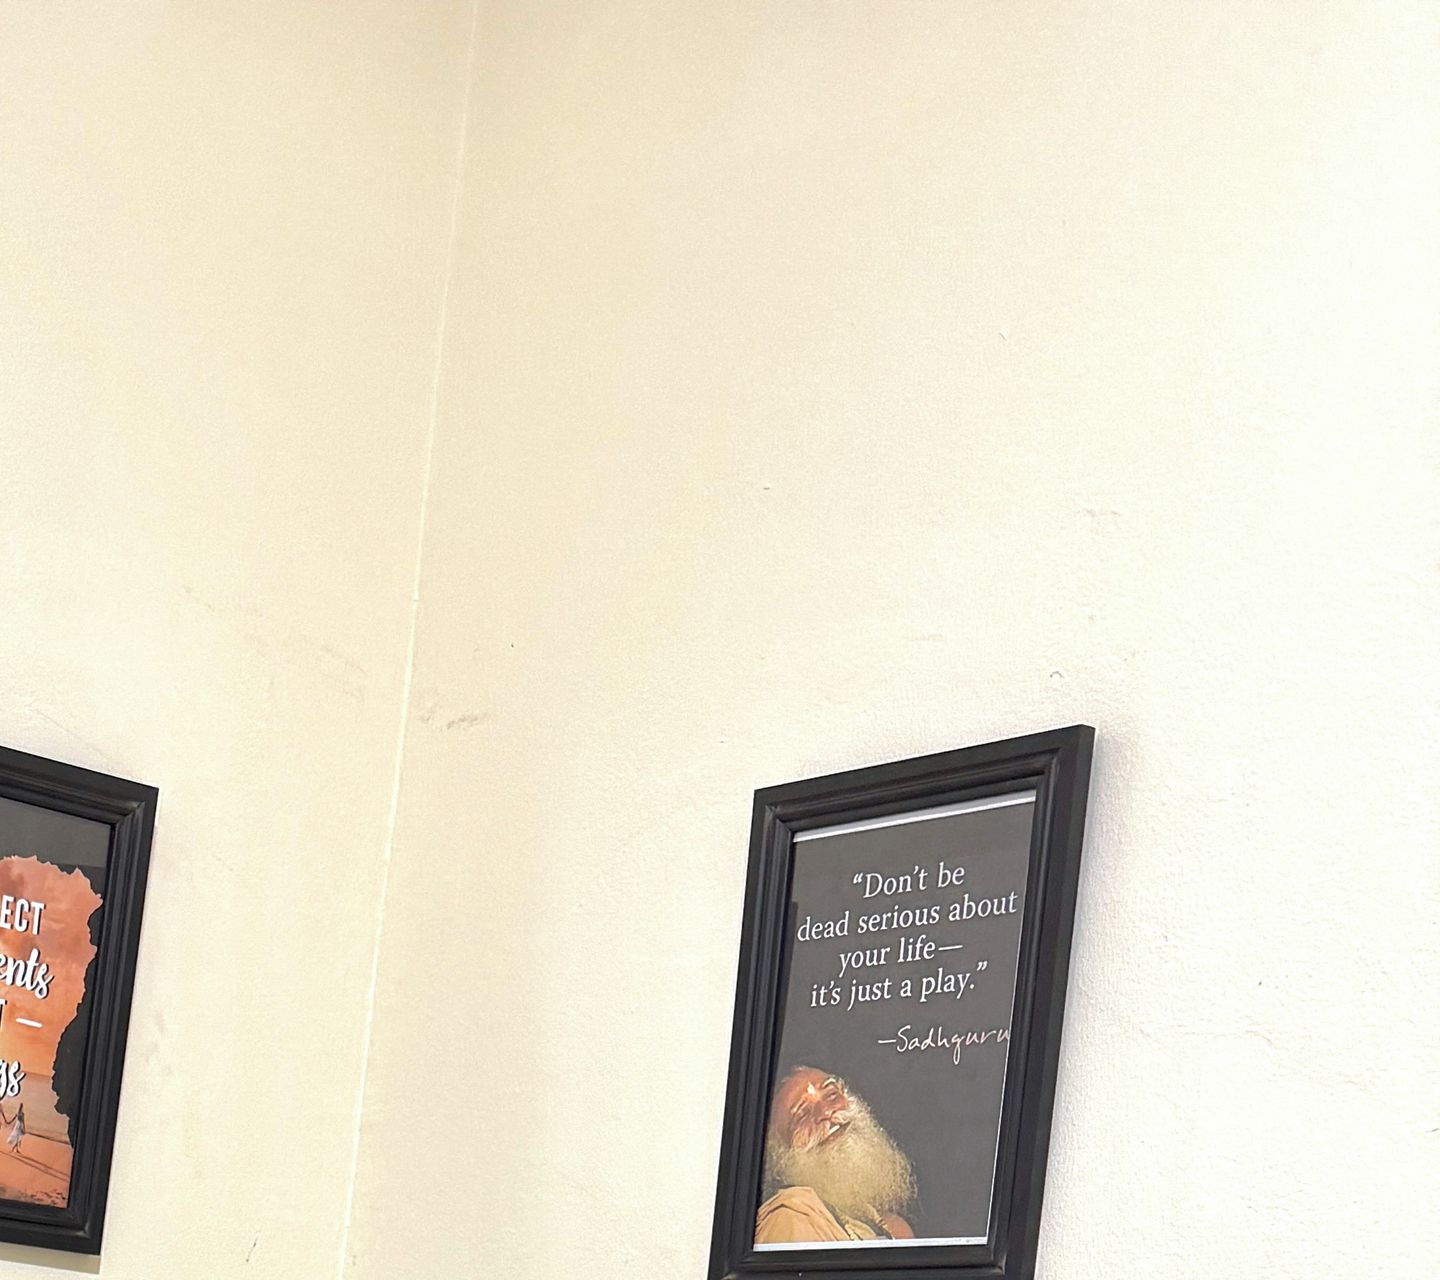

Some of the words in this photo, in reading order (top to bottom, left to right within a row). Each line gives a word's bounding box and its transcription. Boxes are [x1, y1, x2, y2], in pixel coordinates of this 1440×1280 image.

[852, 865, 928, 898] "Don't
[937, 861, 965, 889] be
[796, 910, 850, 942] dead
[857, 905, 941, 934] serious
[948, 890, 1018, 922] about
[838, 946, 891, 978] your
[810, 981, 841, 1007] it's
[847, 977, 892, 1011] just
[900, 979, 912, 998] a
